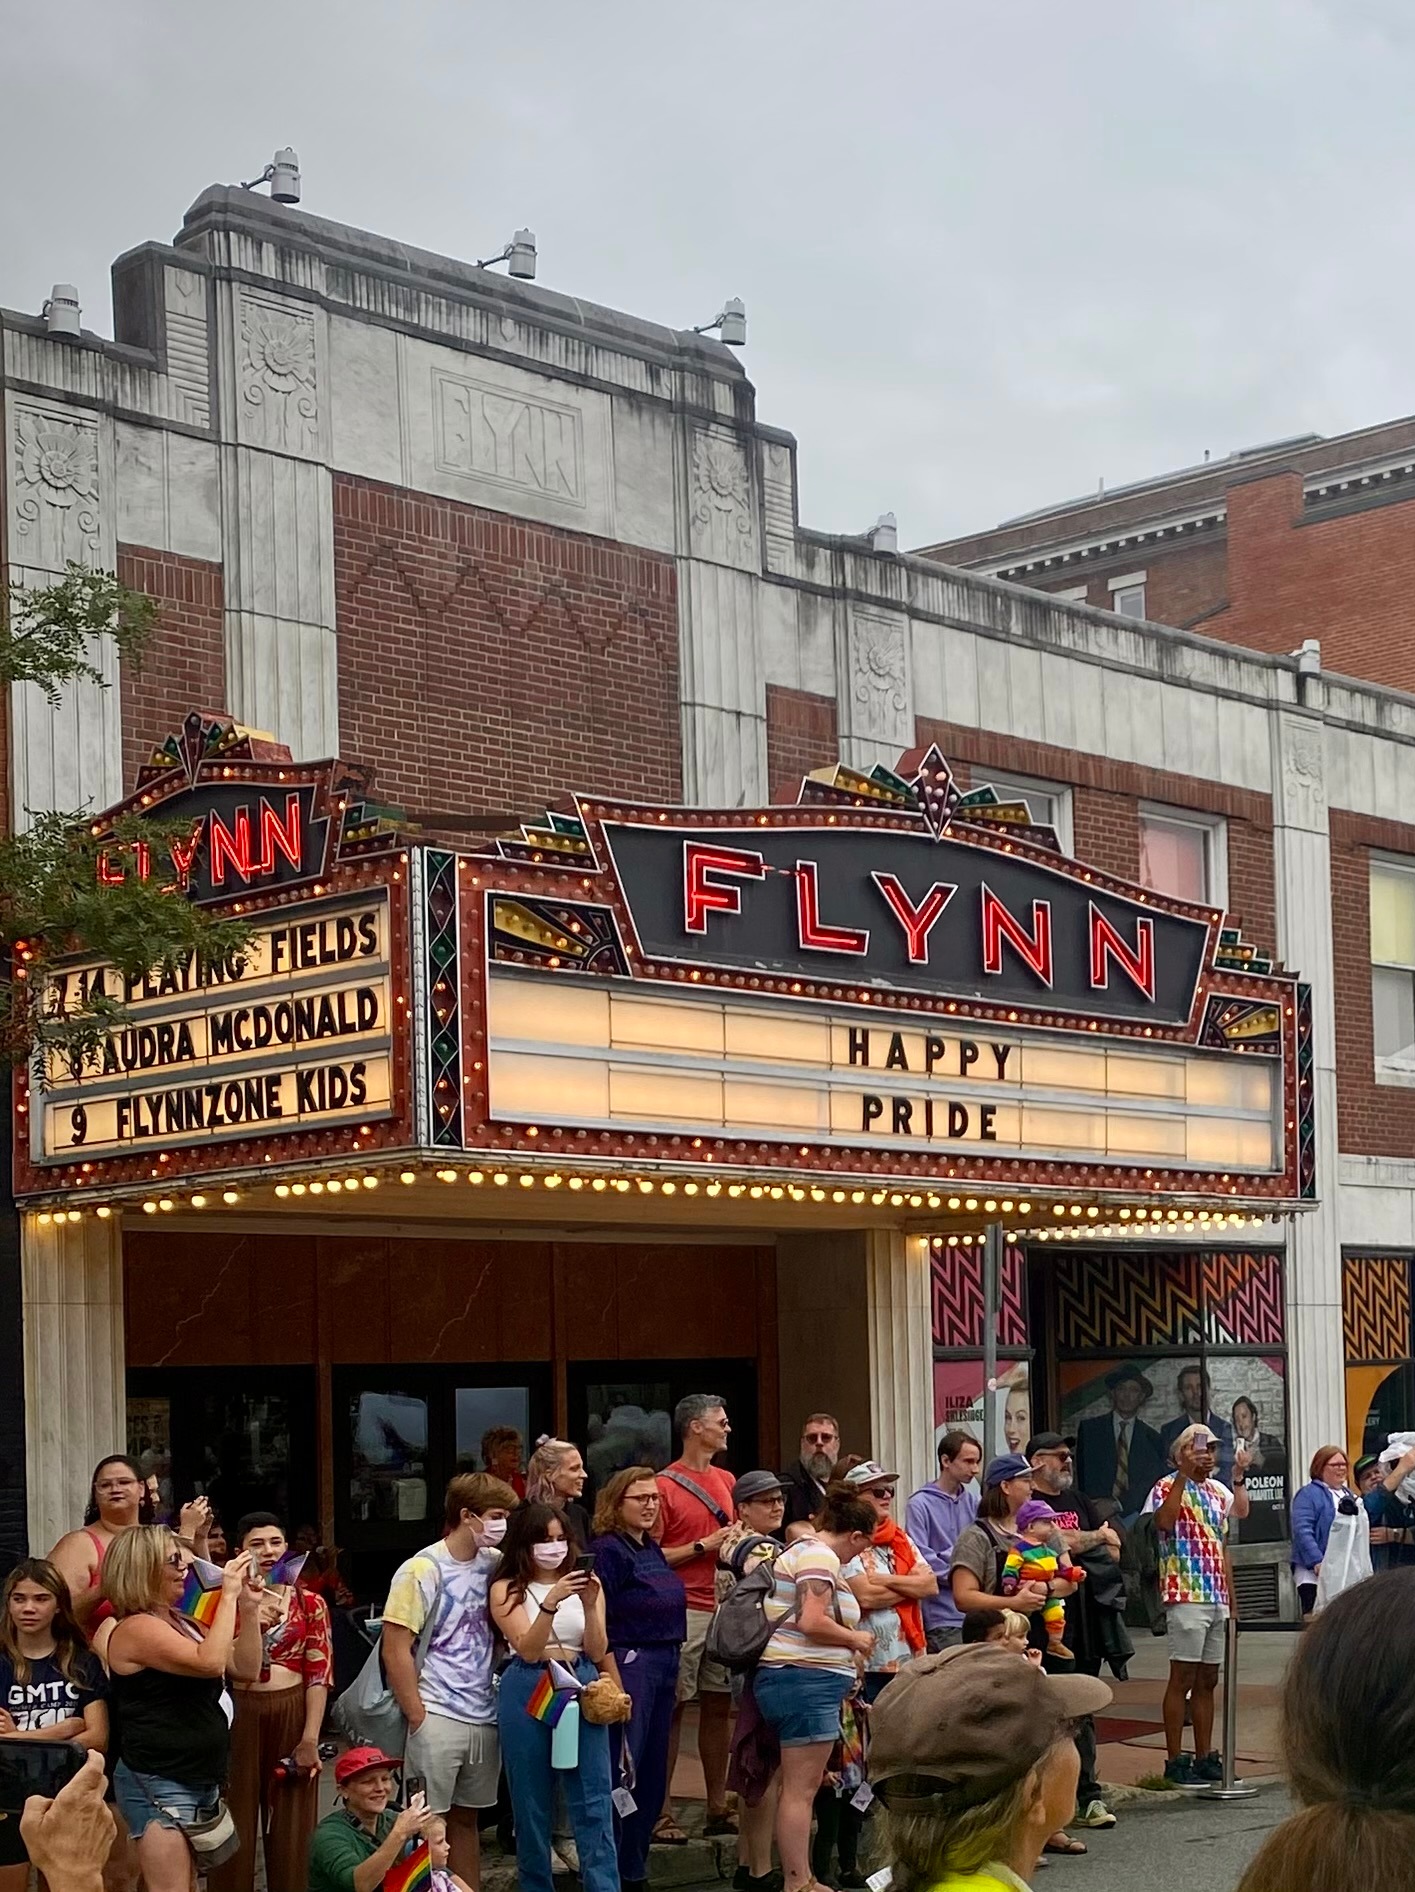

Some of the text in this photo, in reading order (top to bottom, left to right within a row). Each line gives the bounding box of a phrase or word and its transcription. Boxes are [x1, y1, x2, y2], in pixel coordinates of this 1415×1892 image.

[271, 913, 377, 974] FIELDS
[683, 839, 1157, 1003] FLYNN
[102, 1021, 195, 1076] AUDRA
[210, 987, 379, 1057] MCDONALD
[848, 1026, 1011, 1081] HAPPY
[70, 1062, 368, 1146] 9 FLYNNZONE KIDS
[862, 1093, 999, 1142] PRIDE
[945, 1395, 974, 1409] ILIZA
[1245, 1475, 1284, 1489] POLEON
[8, 1680, 80, 1705] GMTC
